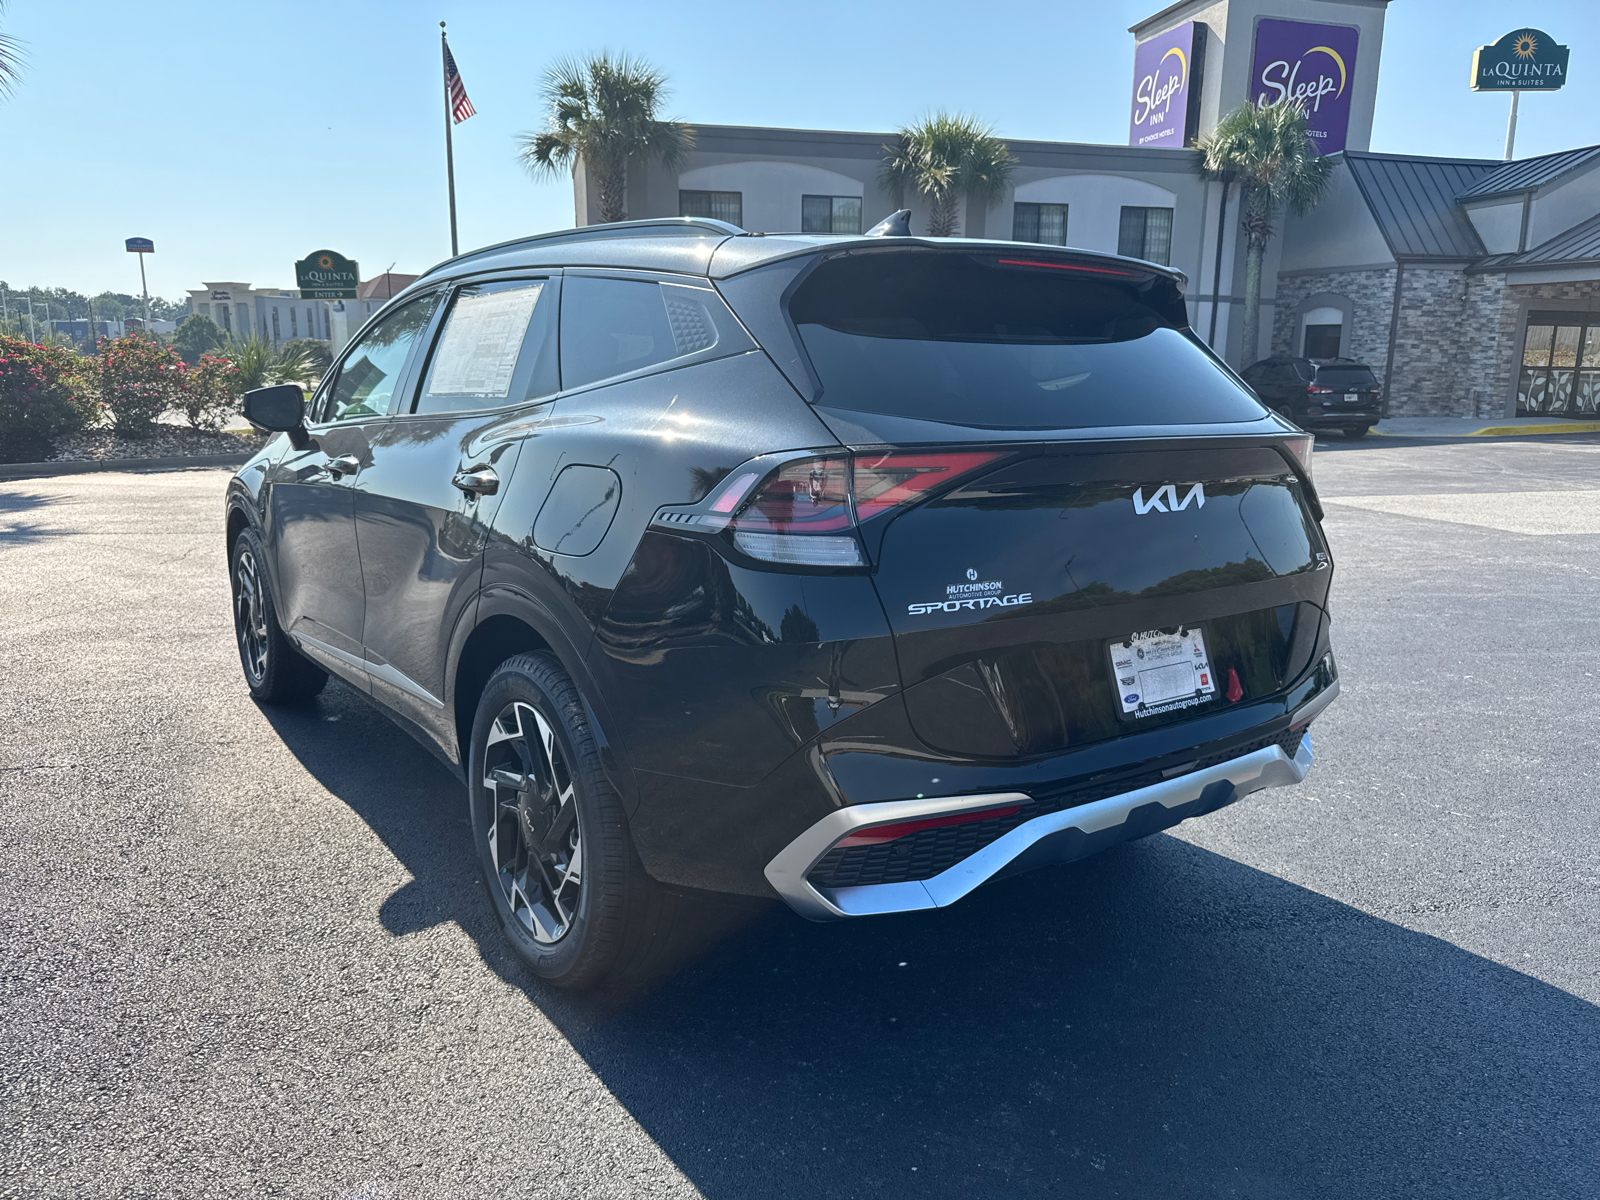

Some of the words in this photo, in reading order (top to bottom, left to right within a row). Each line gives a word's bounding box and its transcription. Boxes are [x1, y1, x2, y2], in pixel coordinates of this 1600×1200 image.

[1259, 60, 1336, 112] Sleep
[1134, 69, 1180, 126] Sleep
[1150, 111, 1164, 126] INN
[1145, 132, 1159, 143] CHOICE
[1159, 127, 1174, 138] HOTELS
[1306, 130, 1327, 138] OTELS
[1133, 482, 1205, 515] KIA
[946, 581, 1002, 595] HUTCHINSON
[948, 591, 982, 600] AUTOMOTIVE
[983, 589, 1002, 597] GROUP
[908, 592, 1033, 615] SPORTAGE
[1115, 659, 1132, 667] GMC
[1127, 695, 1137, 703] Ford
[1134, 694, 1212, 719] Hutchinsonautogroup.com
